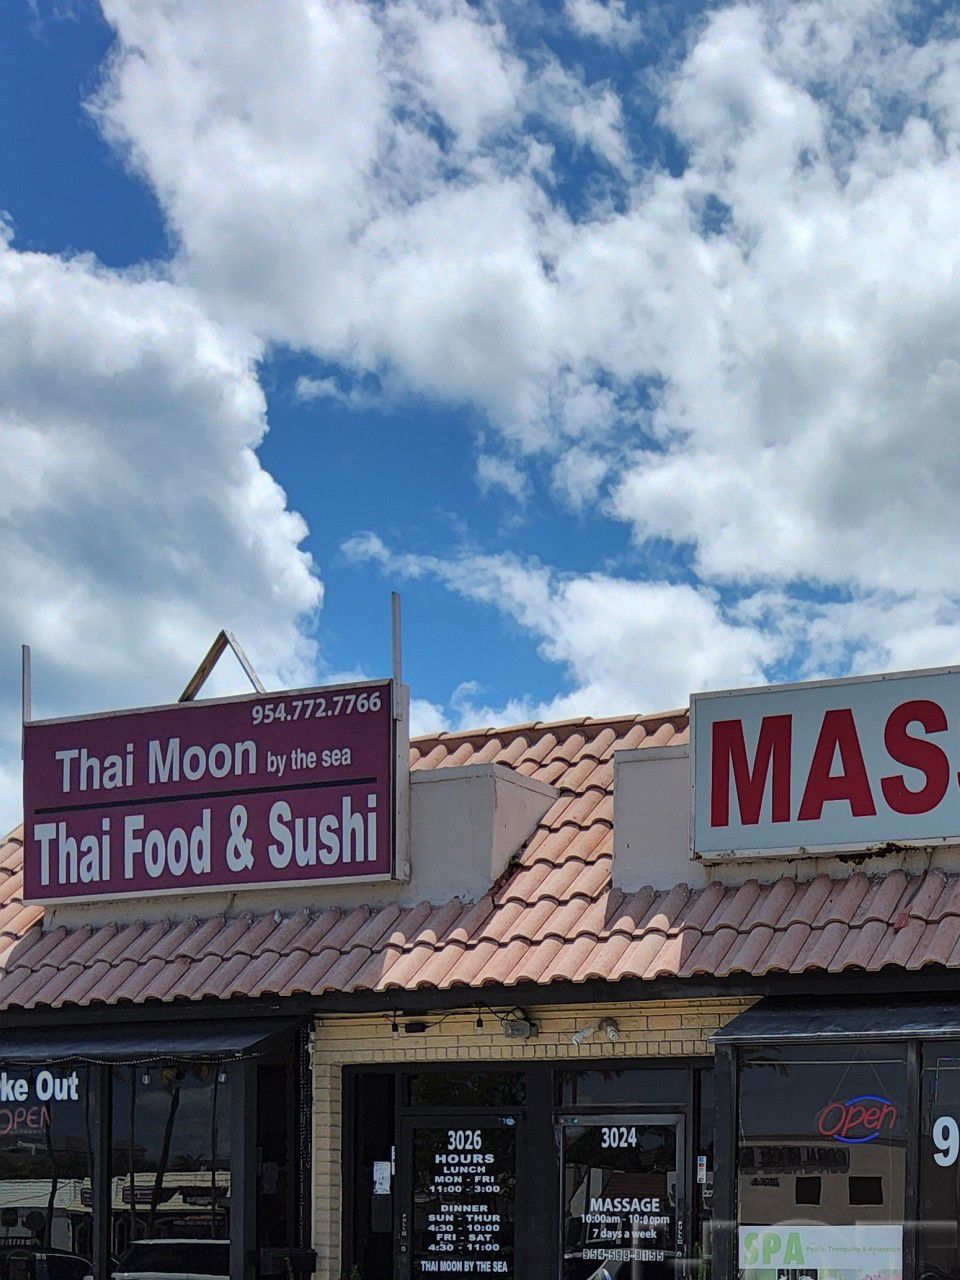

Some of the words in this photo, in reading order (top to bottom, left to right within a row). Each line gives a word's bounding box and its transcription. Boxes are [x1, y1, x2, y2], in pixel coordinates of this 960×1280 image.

[252, 691, 381, 725] 954.772.7766
[55, 743, 134, 792] Thai
[148, 738, 257, 783] Moon
[267, 751, 286, 777] by
[291, 747, 316, 770] the
[321, 747, 351, 767] sea
[34, 817, 110, 885] Thai
[124, 808, 211, 879] Food
[226, 804, 254, 872] &
[268, 794, 377, 868] Sushi
[36, 1071, 79, 1100] Out
[818, 1101, 897, 1137] Open
[448, 1130, 482, 1150] 3026
[601, 1127, 638, 1148] 3024
[435, 1154, 495, 1164] HOURS
[443, 1166, 486, 1174] LUNCH
[429, 1185, 462, 1193] 11:00
[474, 1185, 500, 1193] 3:00
[590, 1198, 660, 1212] MASSAGE
[428, 1214, 454, 1222] SUN
[466, 1214, 501, 1222] THUR
[581, 1214, 621, 1224] 10:00am
[628, 1214, 670, 1226] 10:00pm
[427, 1224, 454, 1232] 4:30
[466, 1224, 500, 1232] 10:00
[593, 1229, 599, 1238] 7
[600, 1229, 622, 1240] days
[632, 1229, 657, 1238] week
[427, 1244, 454, 1252] 4:30
[744, 1232, 805, 1265] SPA
[582, 1249, 664, 1261] 954-599-8155
[421, 1261, 439, 1272] THAI
[440, 1261, 463, 1272] MOON
[464, 1261, 475, 1272] BY
[476, 1261, 492, 1272] THE
[493, 1261, 508, 1272] SEA
